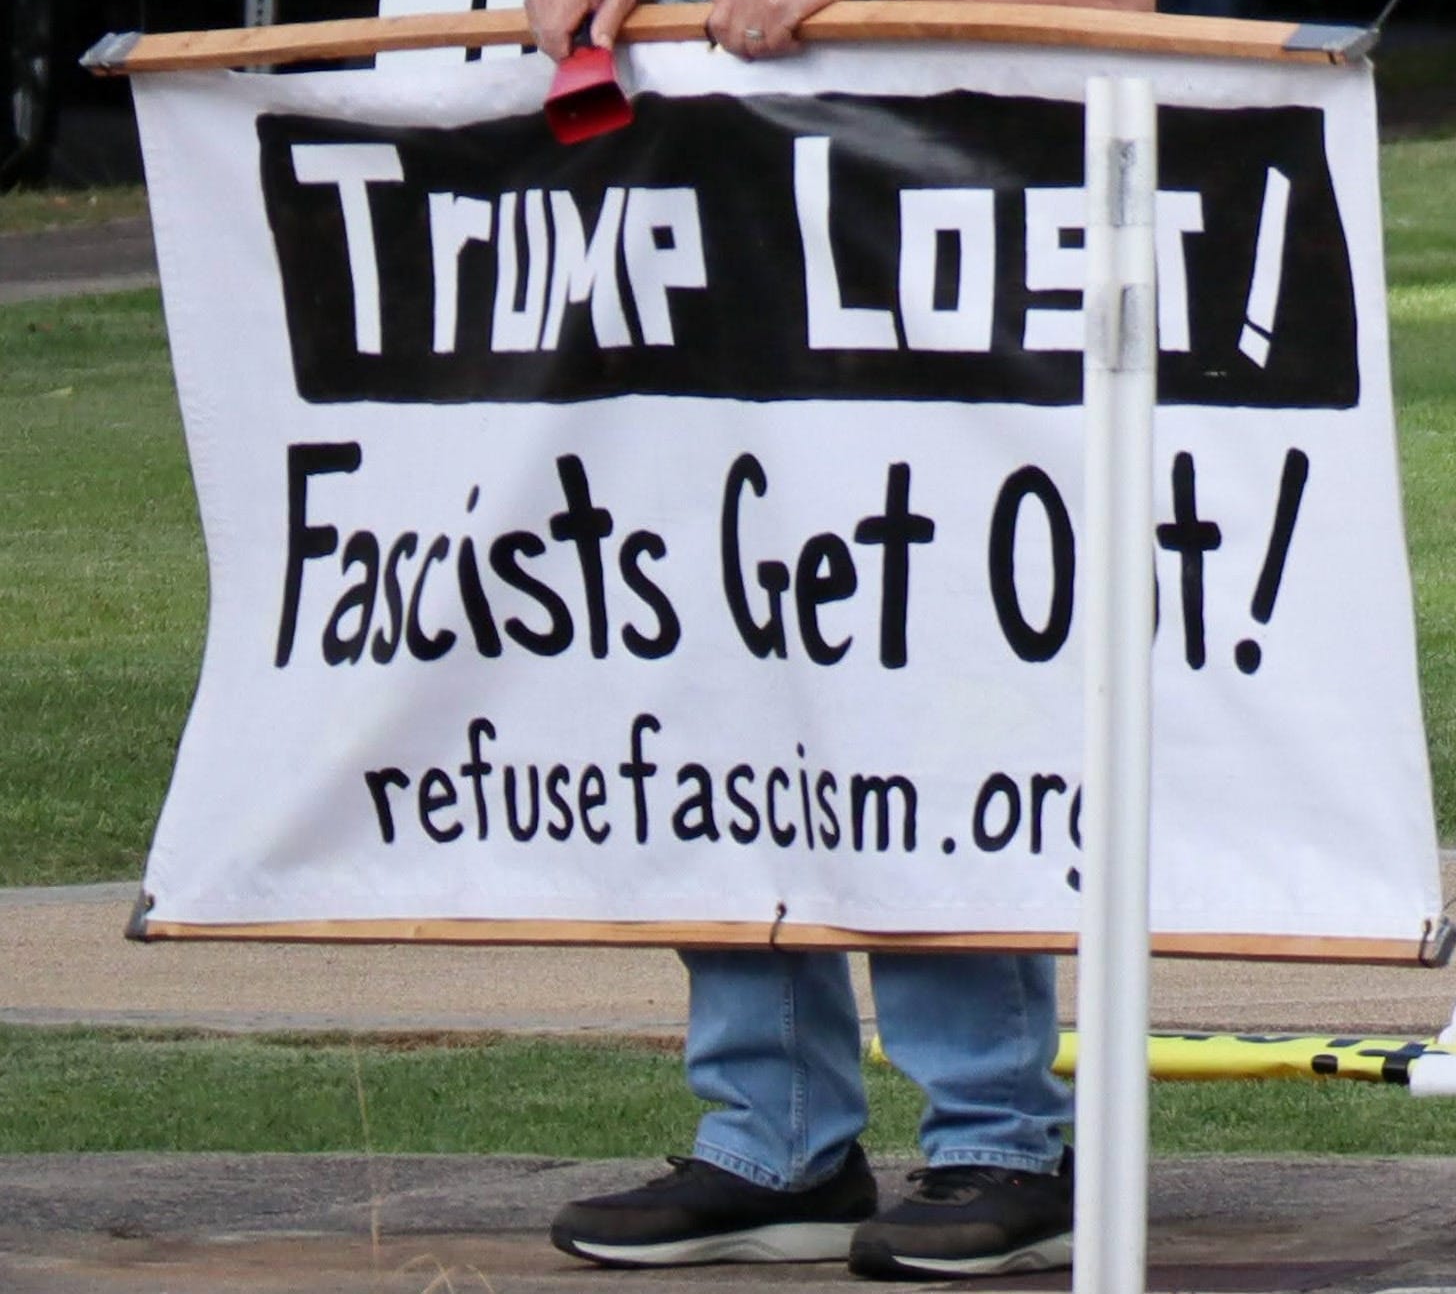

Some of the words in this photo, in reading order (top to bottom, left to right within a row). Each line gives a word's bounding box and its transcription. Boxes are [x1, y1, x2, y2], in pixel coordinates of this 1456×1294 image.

[274, 441, 682, 669] Fascists
[720, 452, 936, 669] Get
[988, 447, 1310, 676] Ot!
